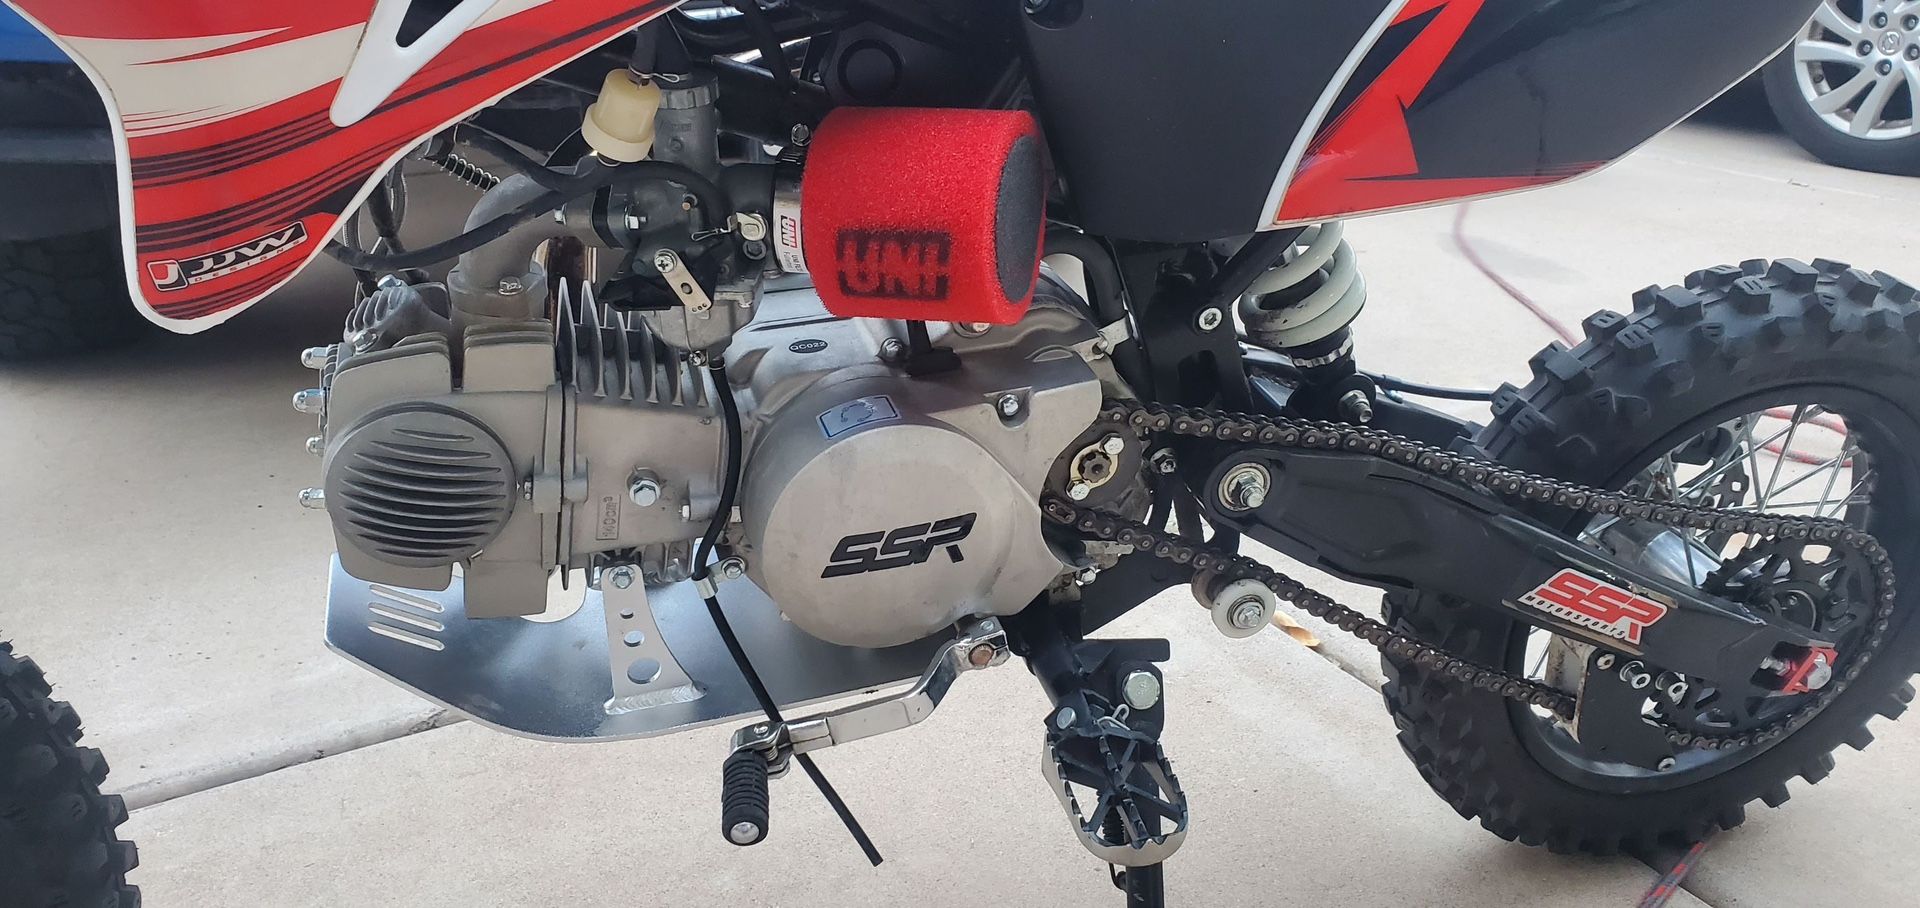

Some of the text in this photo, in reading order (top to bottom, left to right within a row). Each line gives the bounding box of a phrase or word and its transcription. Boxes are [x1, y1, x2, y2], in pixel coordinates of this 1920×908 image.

[780, 214, 797, 248] UNI
[194, 239, 300, 282] DESIGNS
[841, 237, 943, 296] UNI
[789, 341, 827, 352] QC022
[820, 512, 978, 579] SSR
[1524, 595, 1626, 637] MOTORSPORTS
[1534, 571, 1665, 641] SSR
